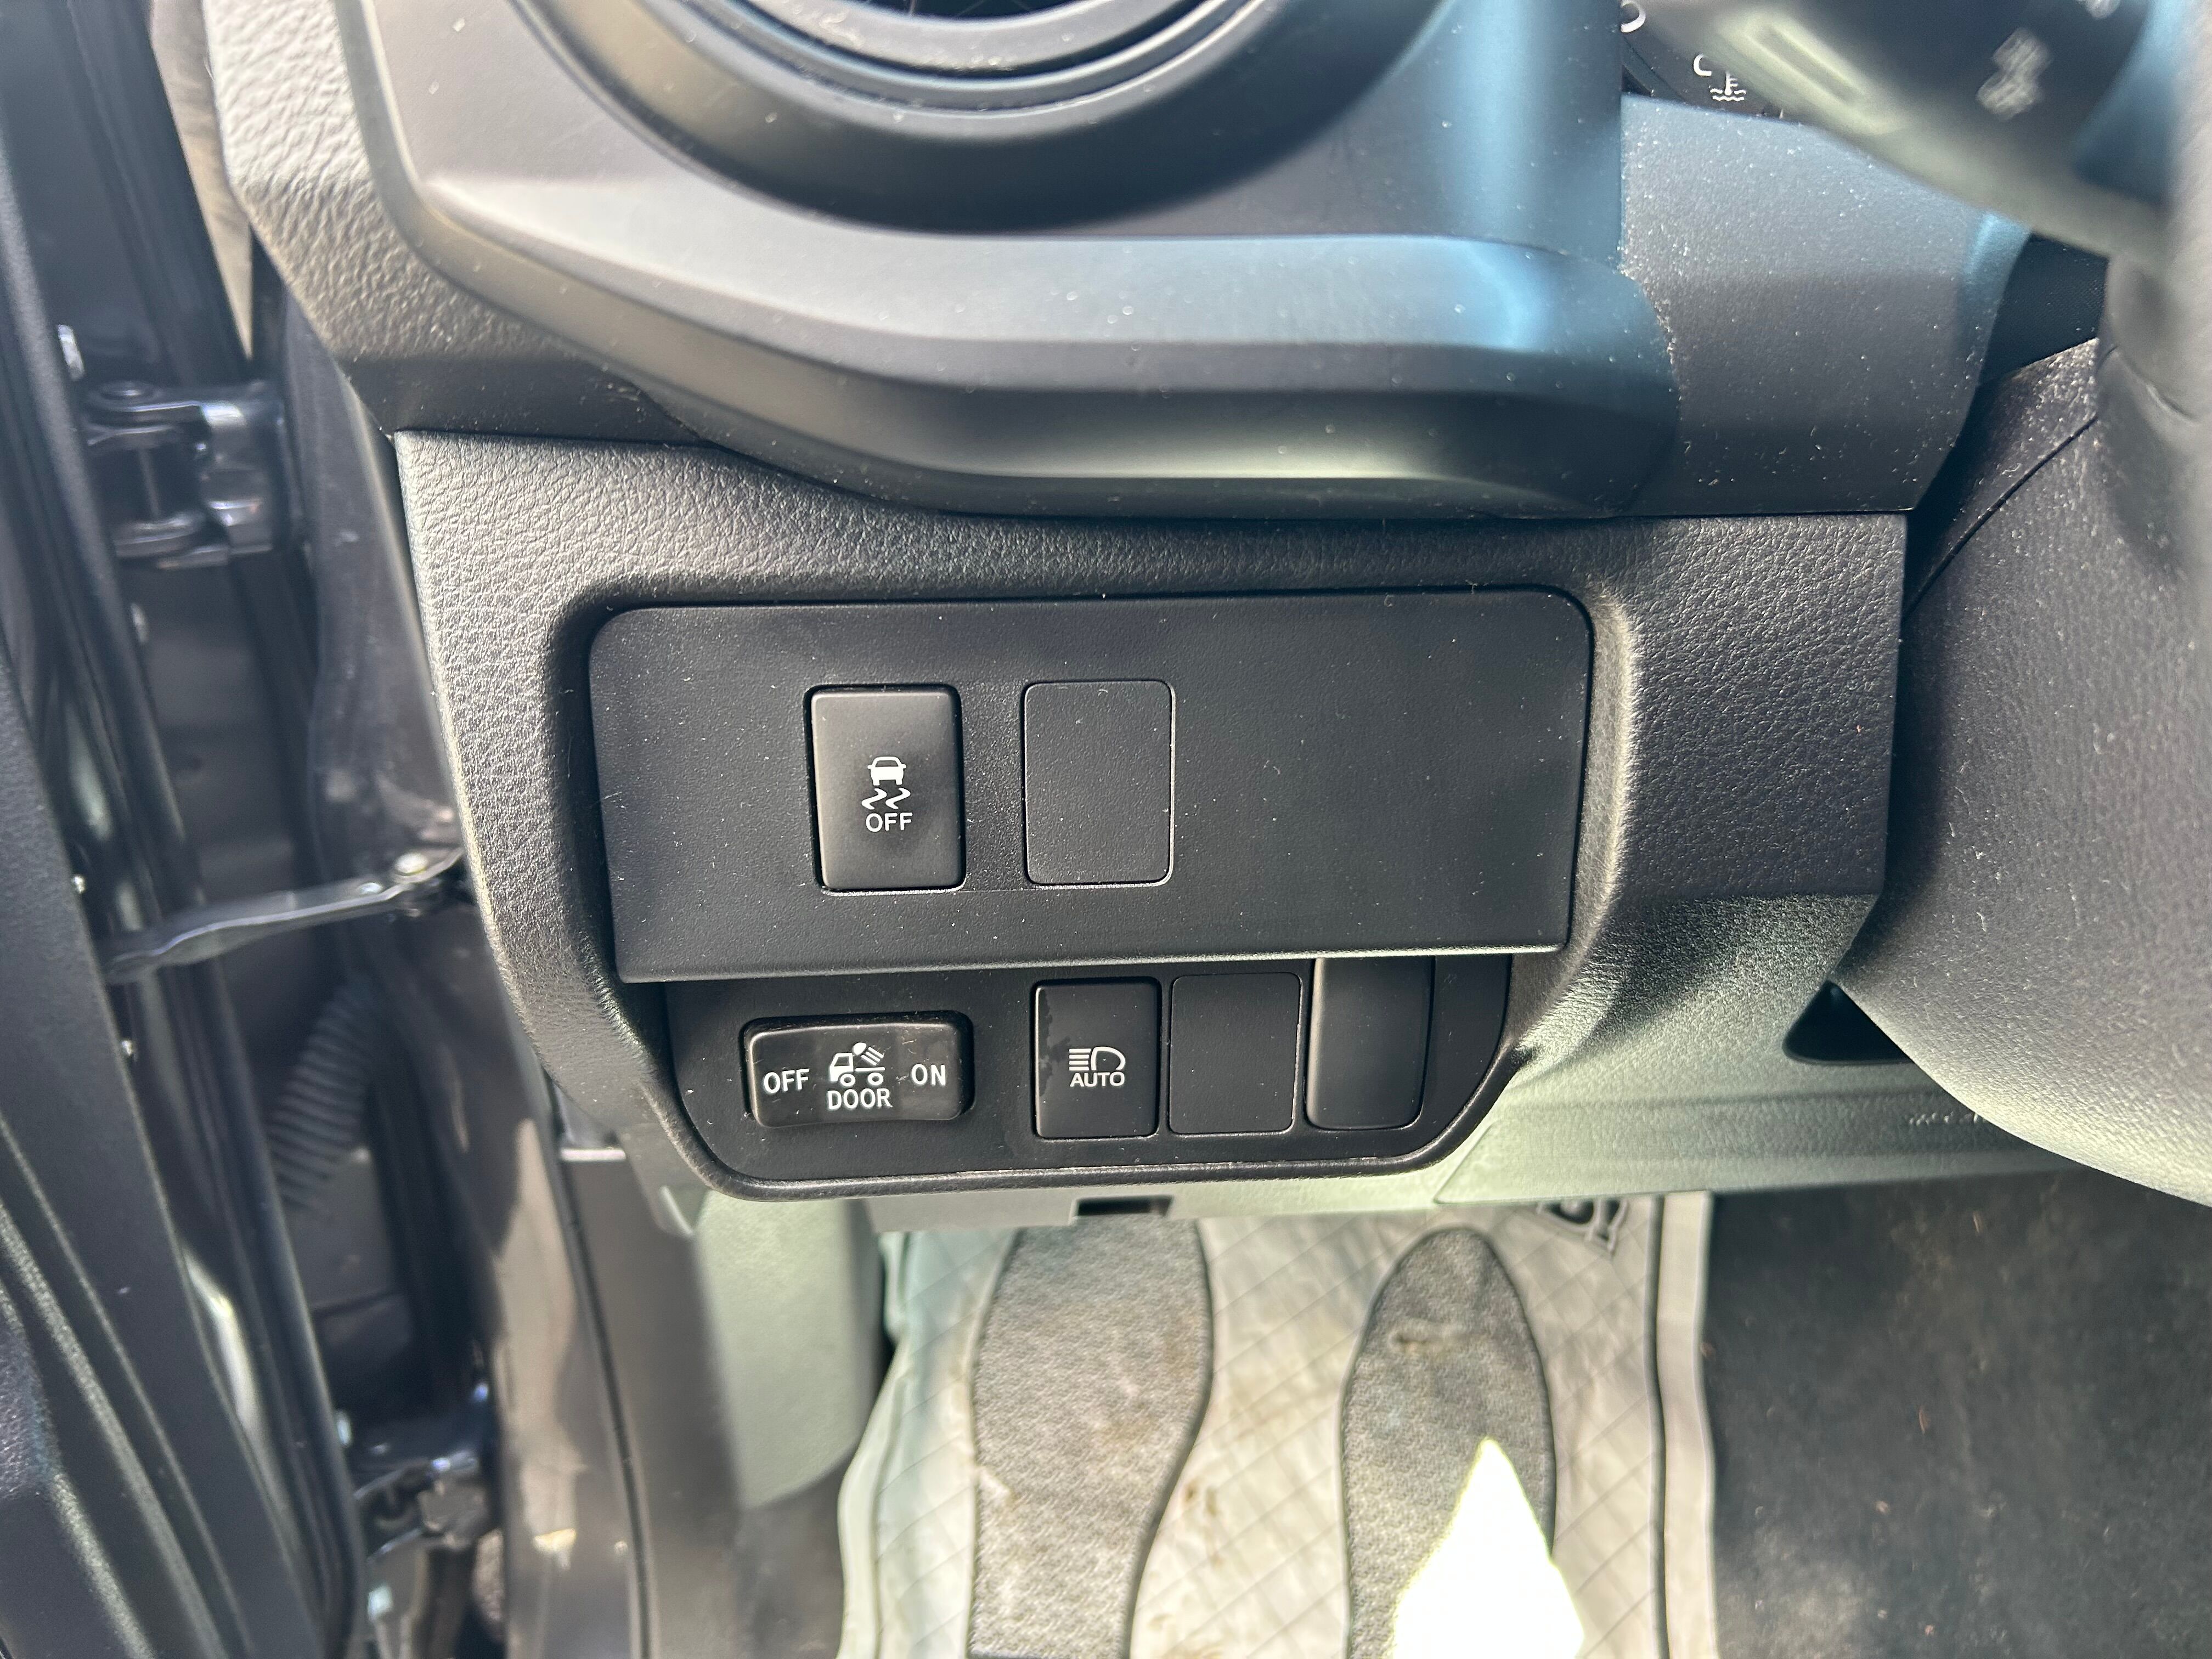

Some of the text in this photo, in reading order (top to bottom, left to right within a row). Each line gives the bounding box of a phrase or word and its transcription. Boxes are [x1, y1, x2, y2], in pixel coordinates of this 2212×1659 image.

[866, 812, 913, 832] OFF
[763, 1068, 810, 1094] OFF
[911, 1063, 946, 1086] ON
[1069, 1071, 1125, 1087] AUTO
[827, 1088, 893, 1110] DOOR
